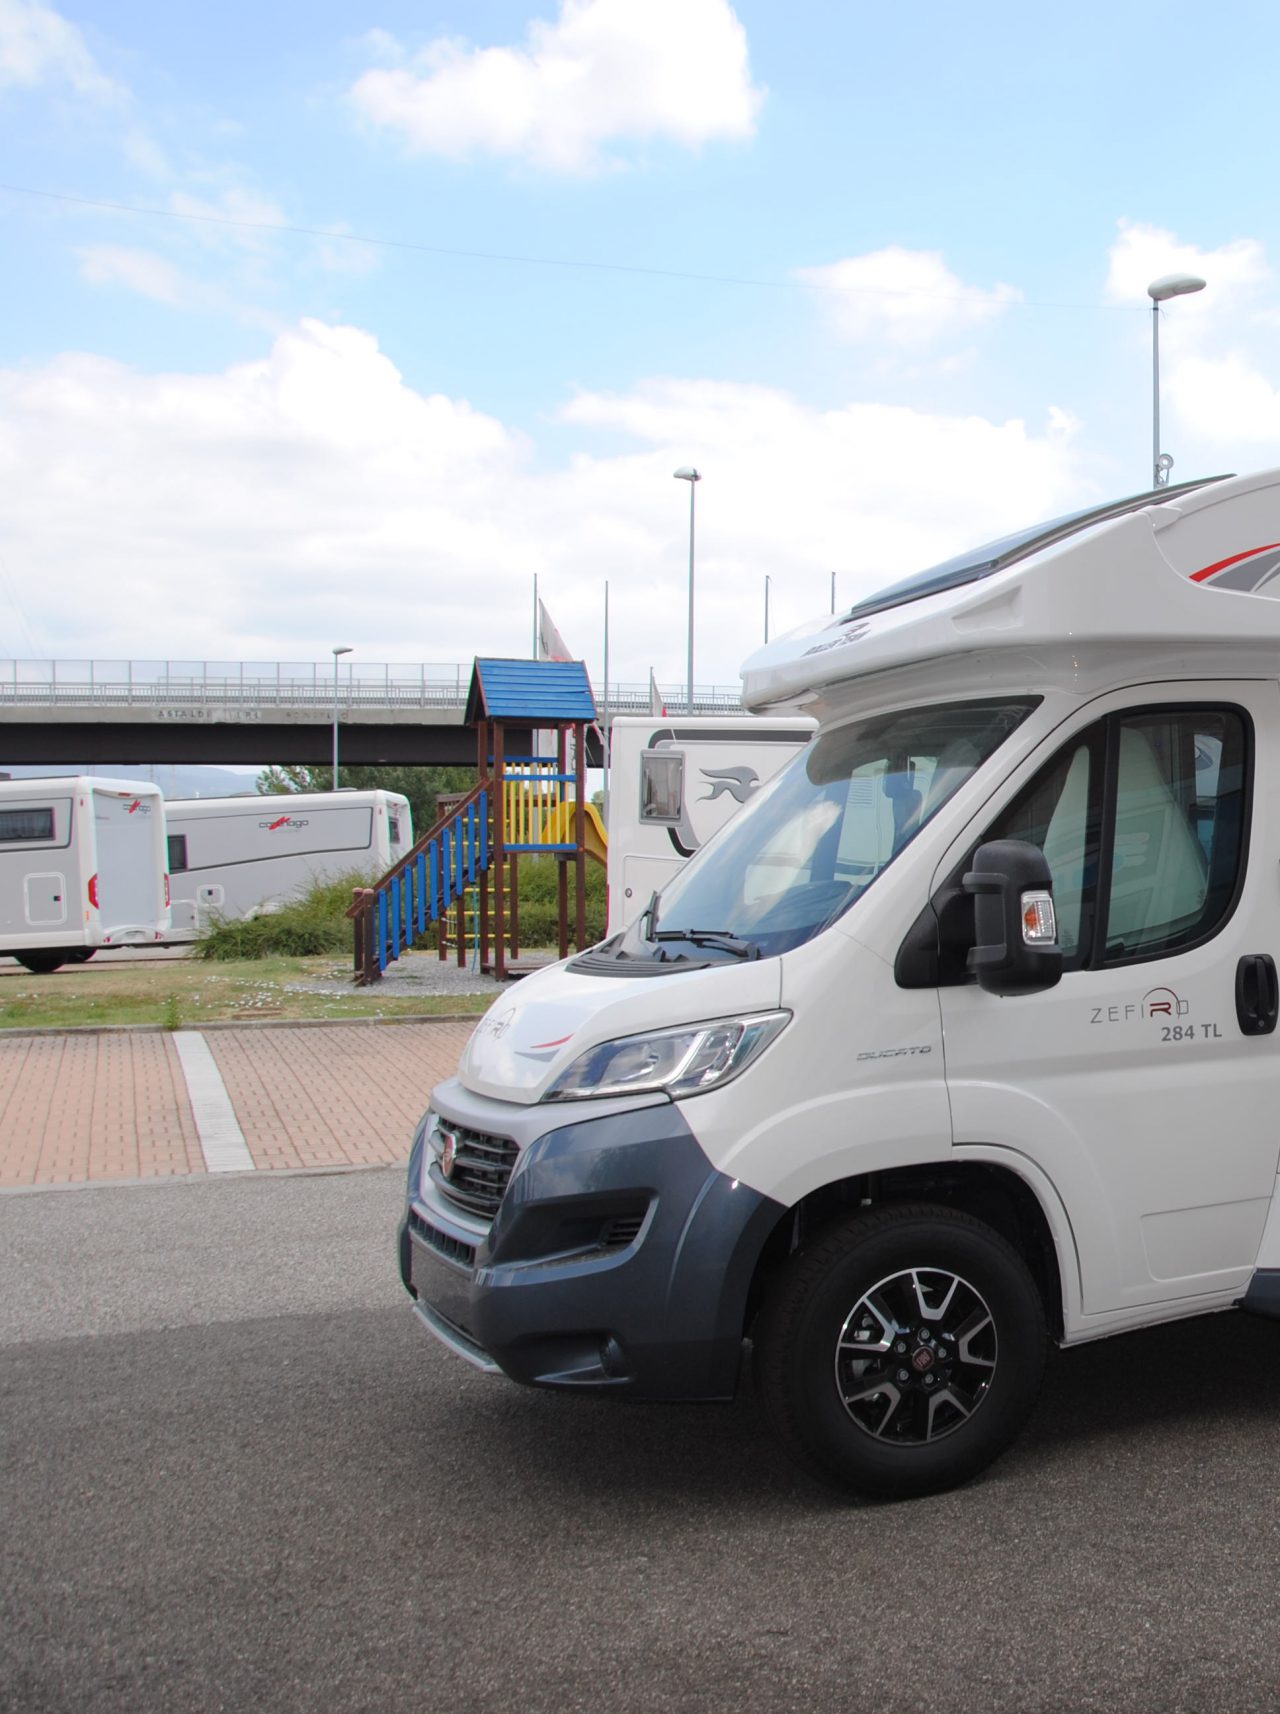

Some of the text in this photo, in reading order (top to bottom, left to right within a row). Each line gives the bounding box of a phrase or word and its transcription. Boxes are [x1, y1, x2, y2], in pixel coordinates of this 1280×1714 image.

[259, 816, 309, 830] cahago
[1090, 1000, 1189, 1024] ZEFIRO
[1160, 1023, 1223, 1042] 284 TL
[856, 1046, 932, 1061] DUCATO
